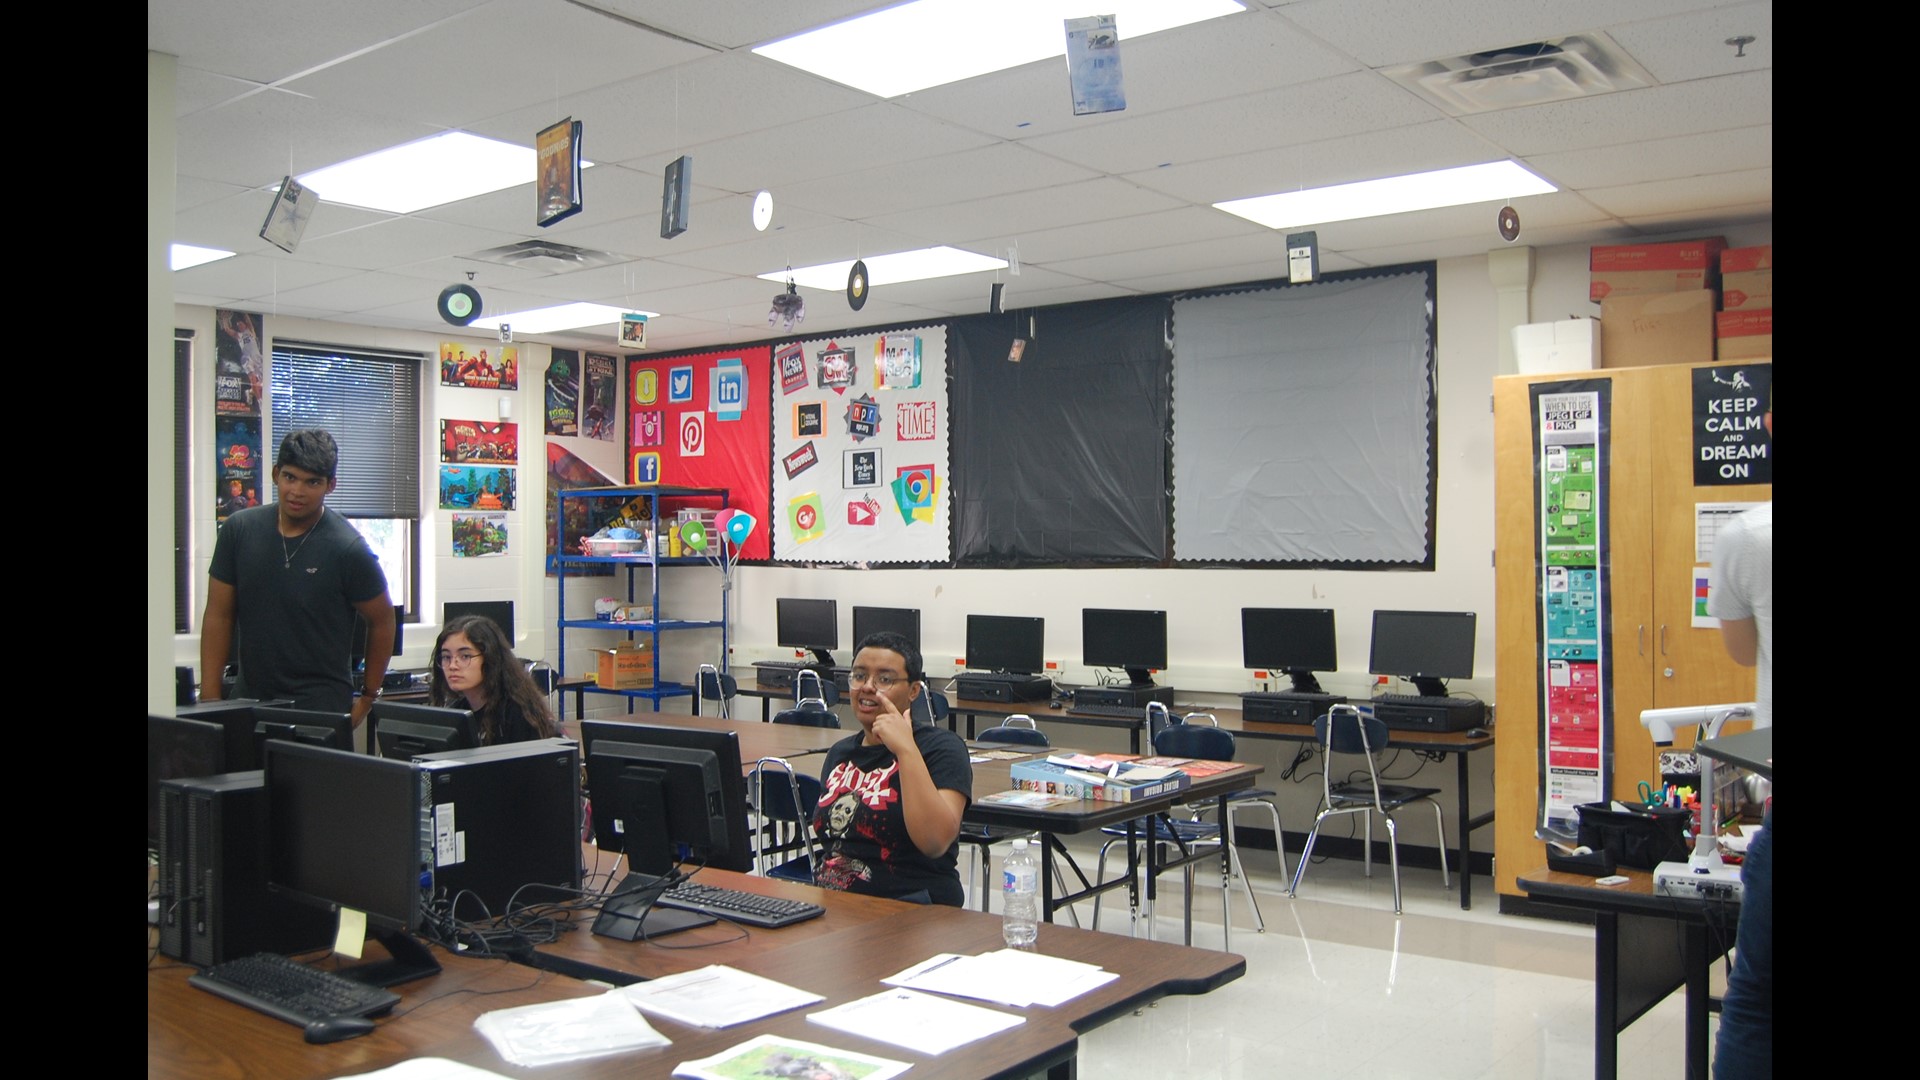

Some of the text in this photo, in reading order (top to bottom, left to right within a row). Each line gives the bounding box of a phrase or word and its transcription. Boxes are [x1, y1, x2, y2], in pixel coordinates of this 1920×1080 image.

[787, 355, 802, 369] FOX
[785, 365, 803, 378] NEWS
[721, 376, 738, 400] in
[1545, 400, 1591, 411] WHEN TO USE
[1708, 397, 1758, 414] KEEP
[854, 407, 874, 421] npr
[1548, 410, 1590, 420] JPEG GIF
[901, 410, 932, 435] TIME
[1556, 421, 1575, 430] PNG
[1704, 416, 1761, 432] CALM
[1723, 434, 1744, 442] AND
[1701, 444, 1766, 461] DREAM
[1719, 464, 1749, 478] ON
